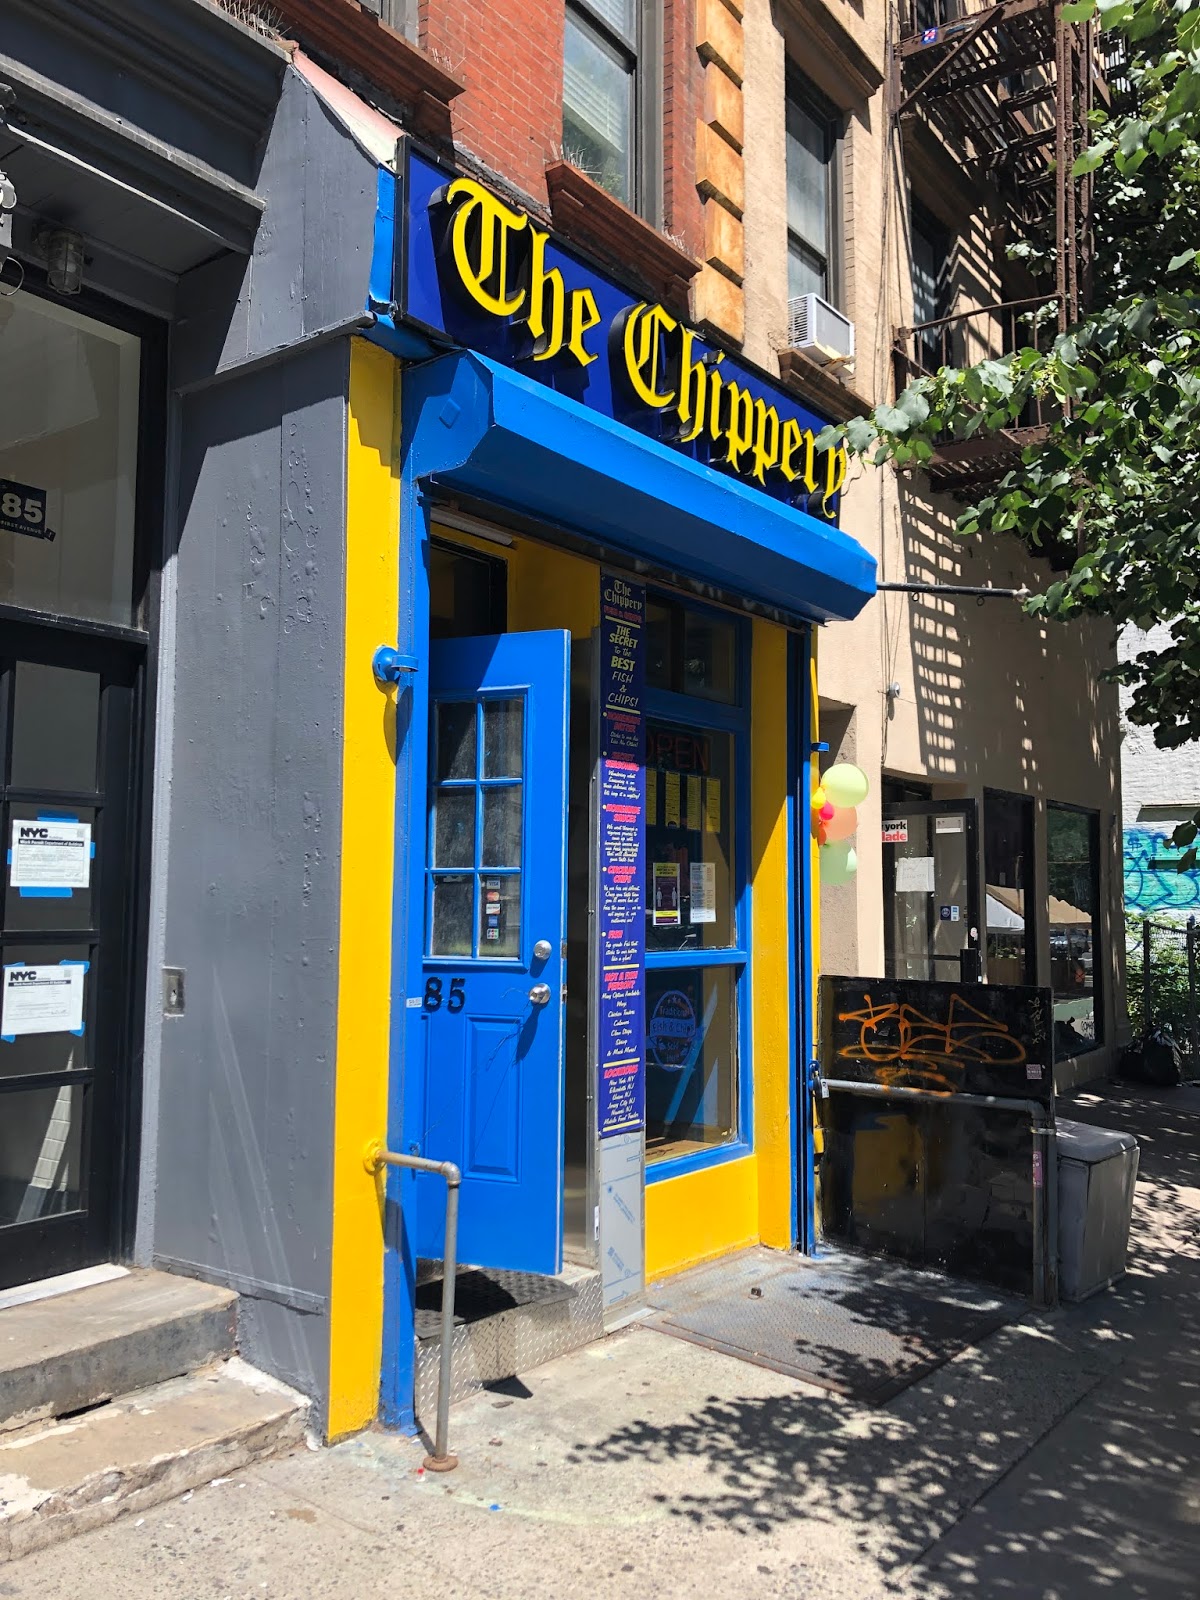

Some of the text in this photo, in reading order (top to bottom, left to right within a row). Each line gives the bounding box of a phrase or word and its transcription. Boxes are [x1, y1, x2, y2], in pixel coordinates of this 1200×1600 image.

[447, 178, 601, 367] The
[1, 492, 43, 524] 85
[19, 524, 42, 535] AVENUE
[614, 580, 632, 597] The
[604, 588, 643, 610] Chippery
[616, 625, 631, 637] THE
[609, 633, 638, 649] SECRET
[614, 646, 621, 655] to
[611, 656, 635, 672] BEST
[612, 671, 634, 683] FISH
[619, 684, 627, 693] &
[608, 692, 639, 707] CHIPS!
[885, 821, 907, 832] york
[20, 827, 49, 839] NYC
[882, 831, 907, 842] lade
[10, 970, 37, 982] NYC
[425, 976, 466, 1014] 85
[627, 1075, 636, 1083] NY
[627, 1083, 635, 1091] NJ
[624, 1090, 632, 1099] NJ
[619, 1099, 628, 1107] City
[628, 1097, 636, 1105] NJ
[625, 1105, 633, 1113] NJ
